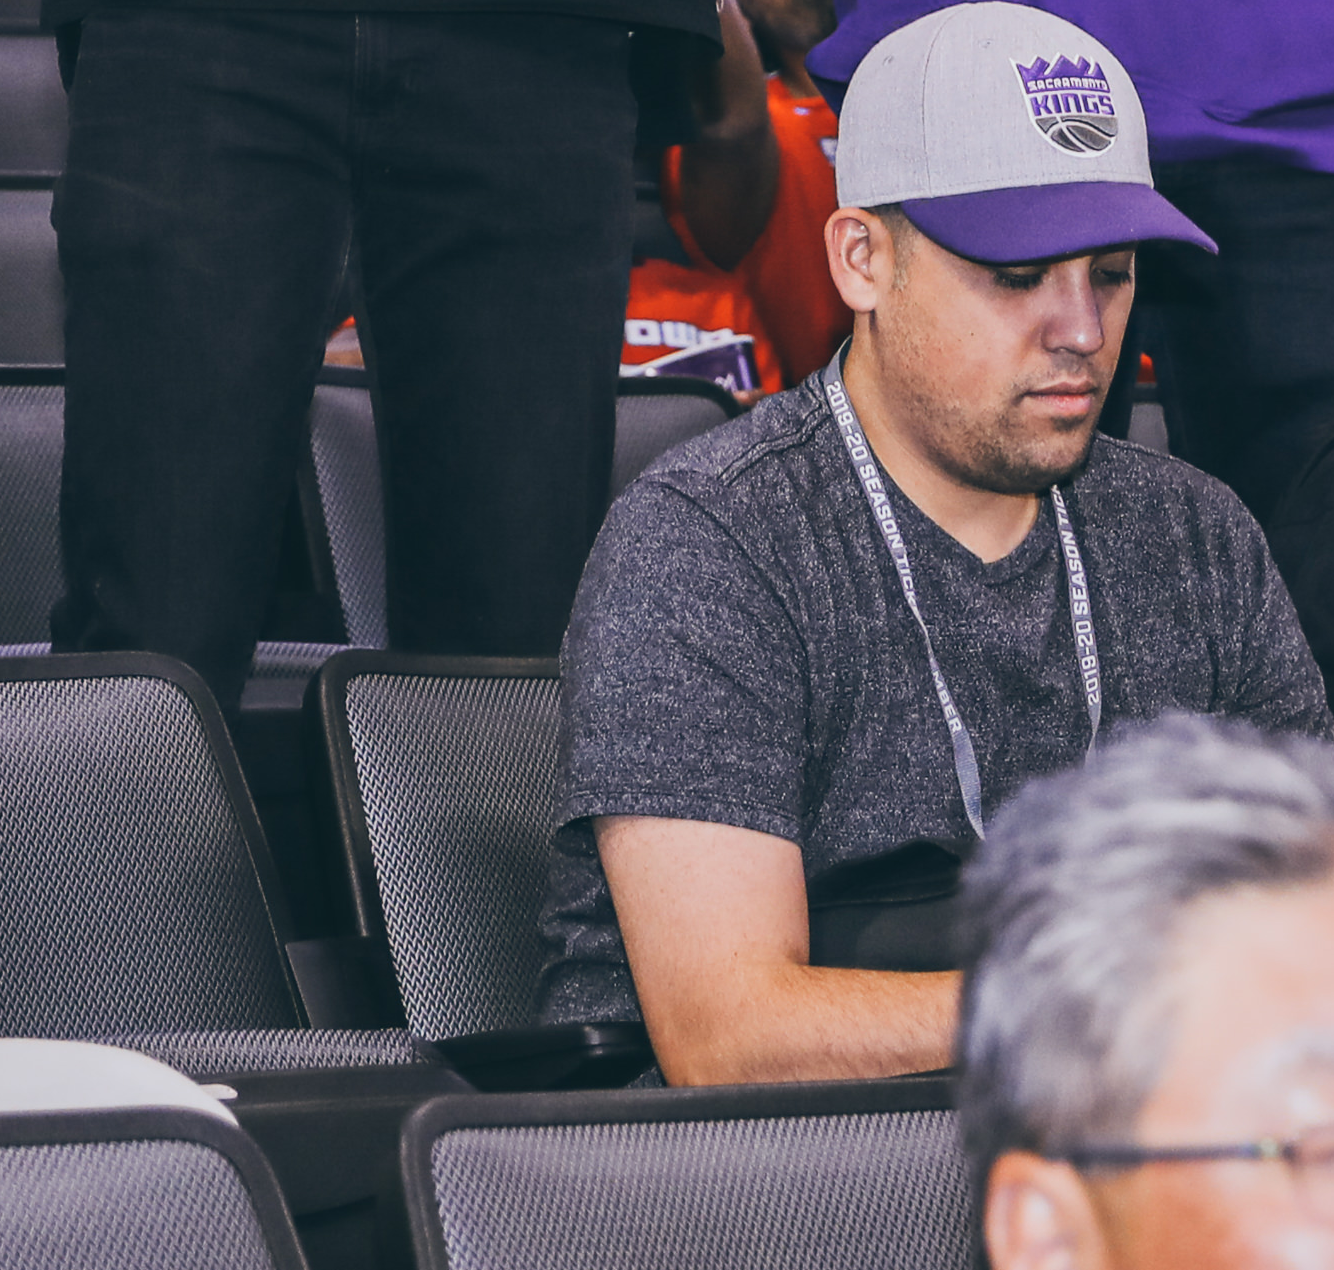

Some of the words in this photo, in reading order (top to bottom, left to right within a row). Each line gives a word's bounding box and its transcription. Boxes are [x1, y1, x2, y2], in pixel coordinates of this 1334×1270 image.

[1026, 76, 1109, 92] SACRAMENTO
[1030, 92, 1116, 117] KINGS
[827, 381, 869, 461] 2019-20
[859, 463, 904, 550] SEASON
[1063, 530, 1089, 616] SEASON
[1075, 619, 1101, 706] 2019-20
